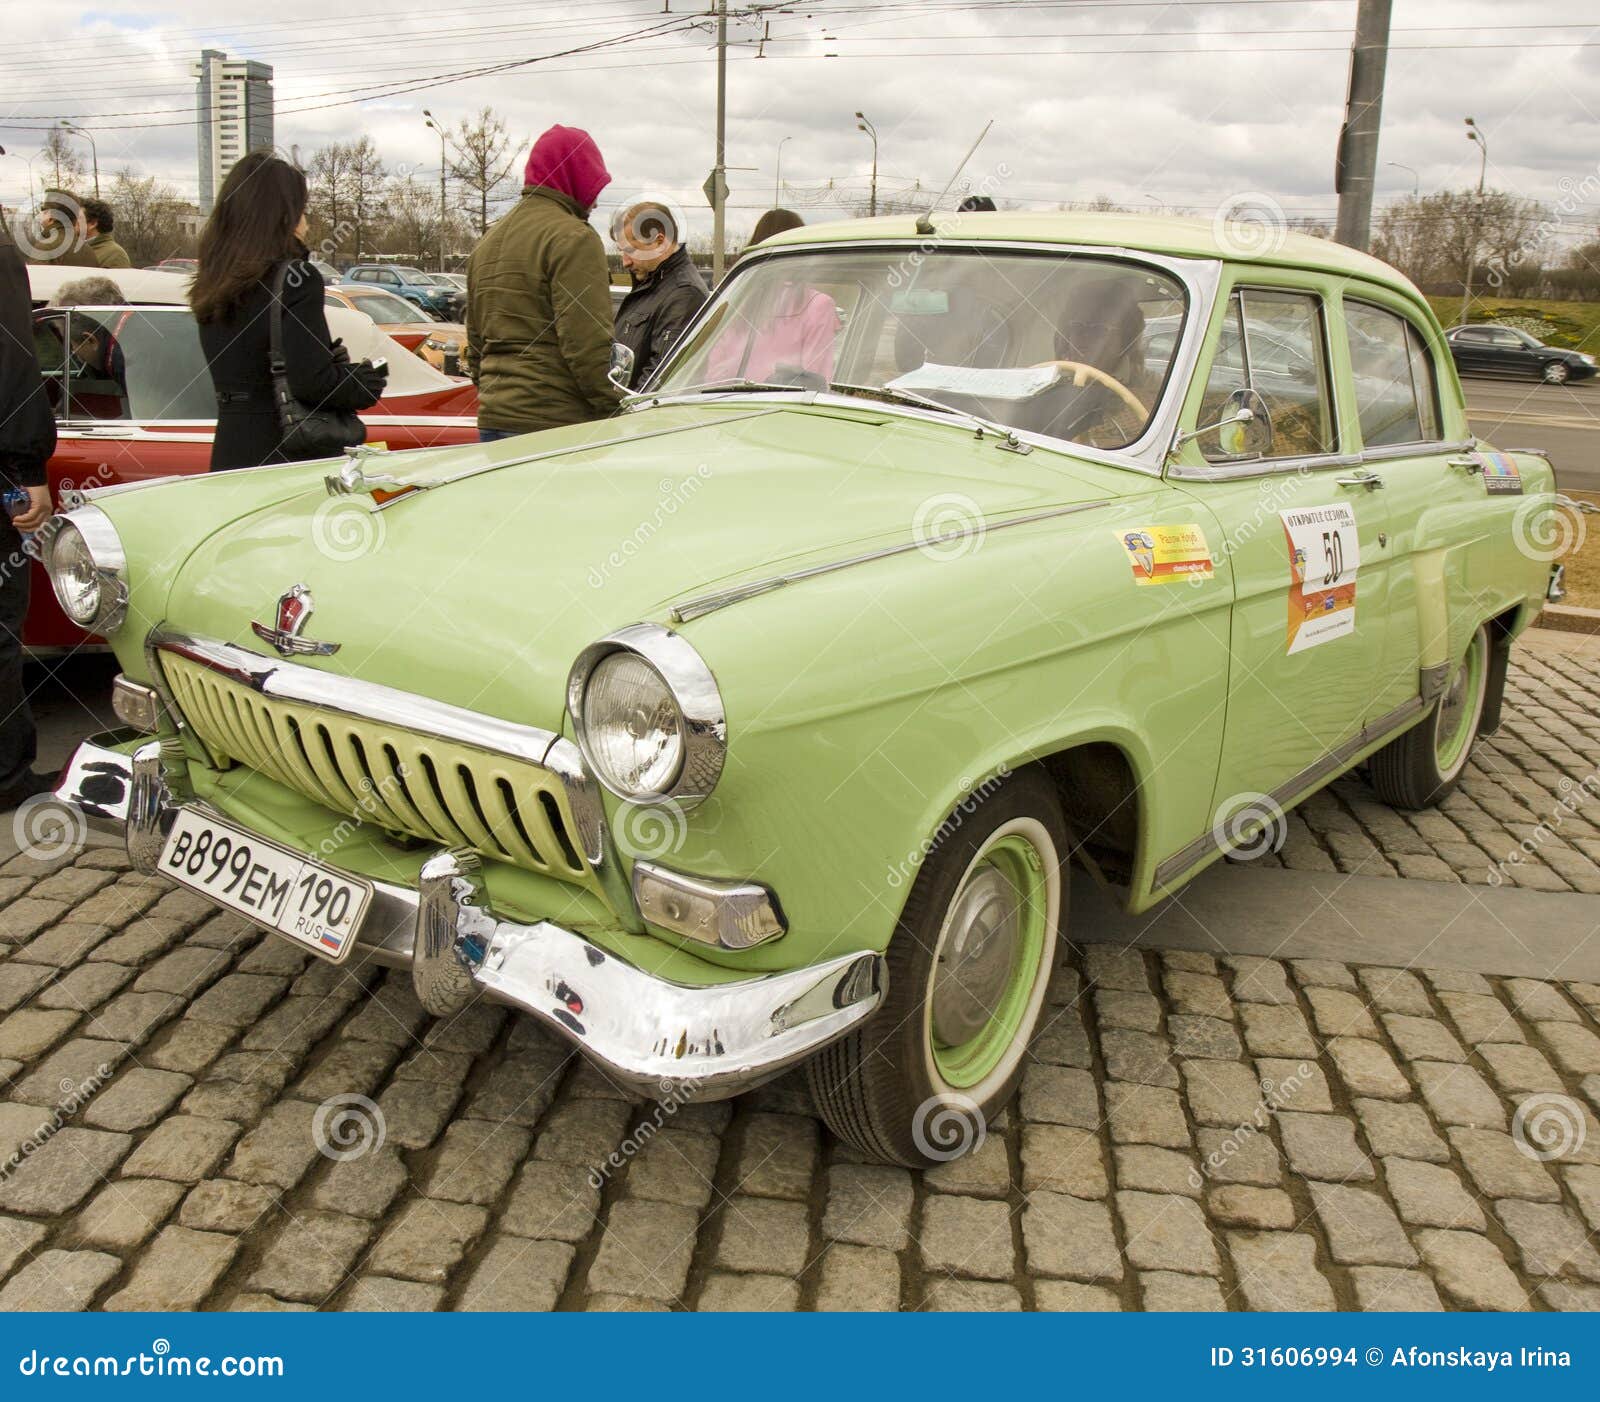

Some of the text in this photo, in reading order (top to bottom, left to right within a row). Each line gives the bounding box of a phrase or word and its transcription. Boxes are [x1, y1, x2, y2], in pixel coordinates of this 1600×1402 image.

[1322, 530, 1344, 585] 50
[299, 873, 351, 927] 190
[294, 916, 323, 940] RUS
